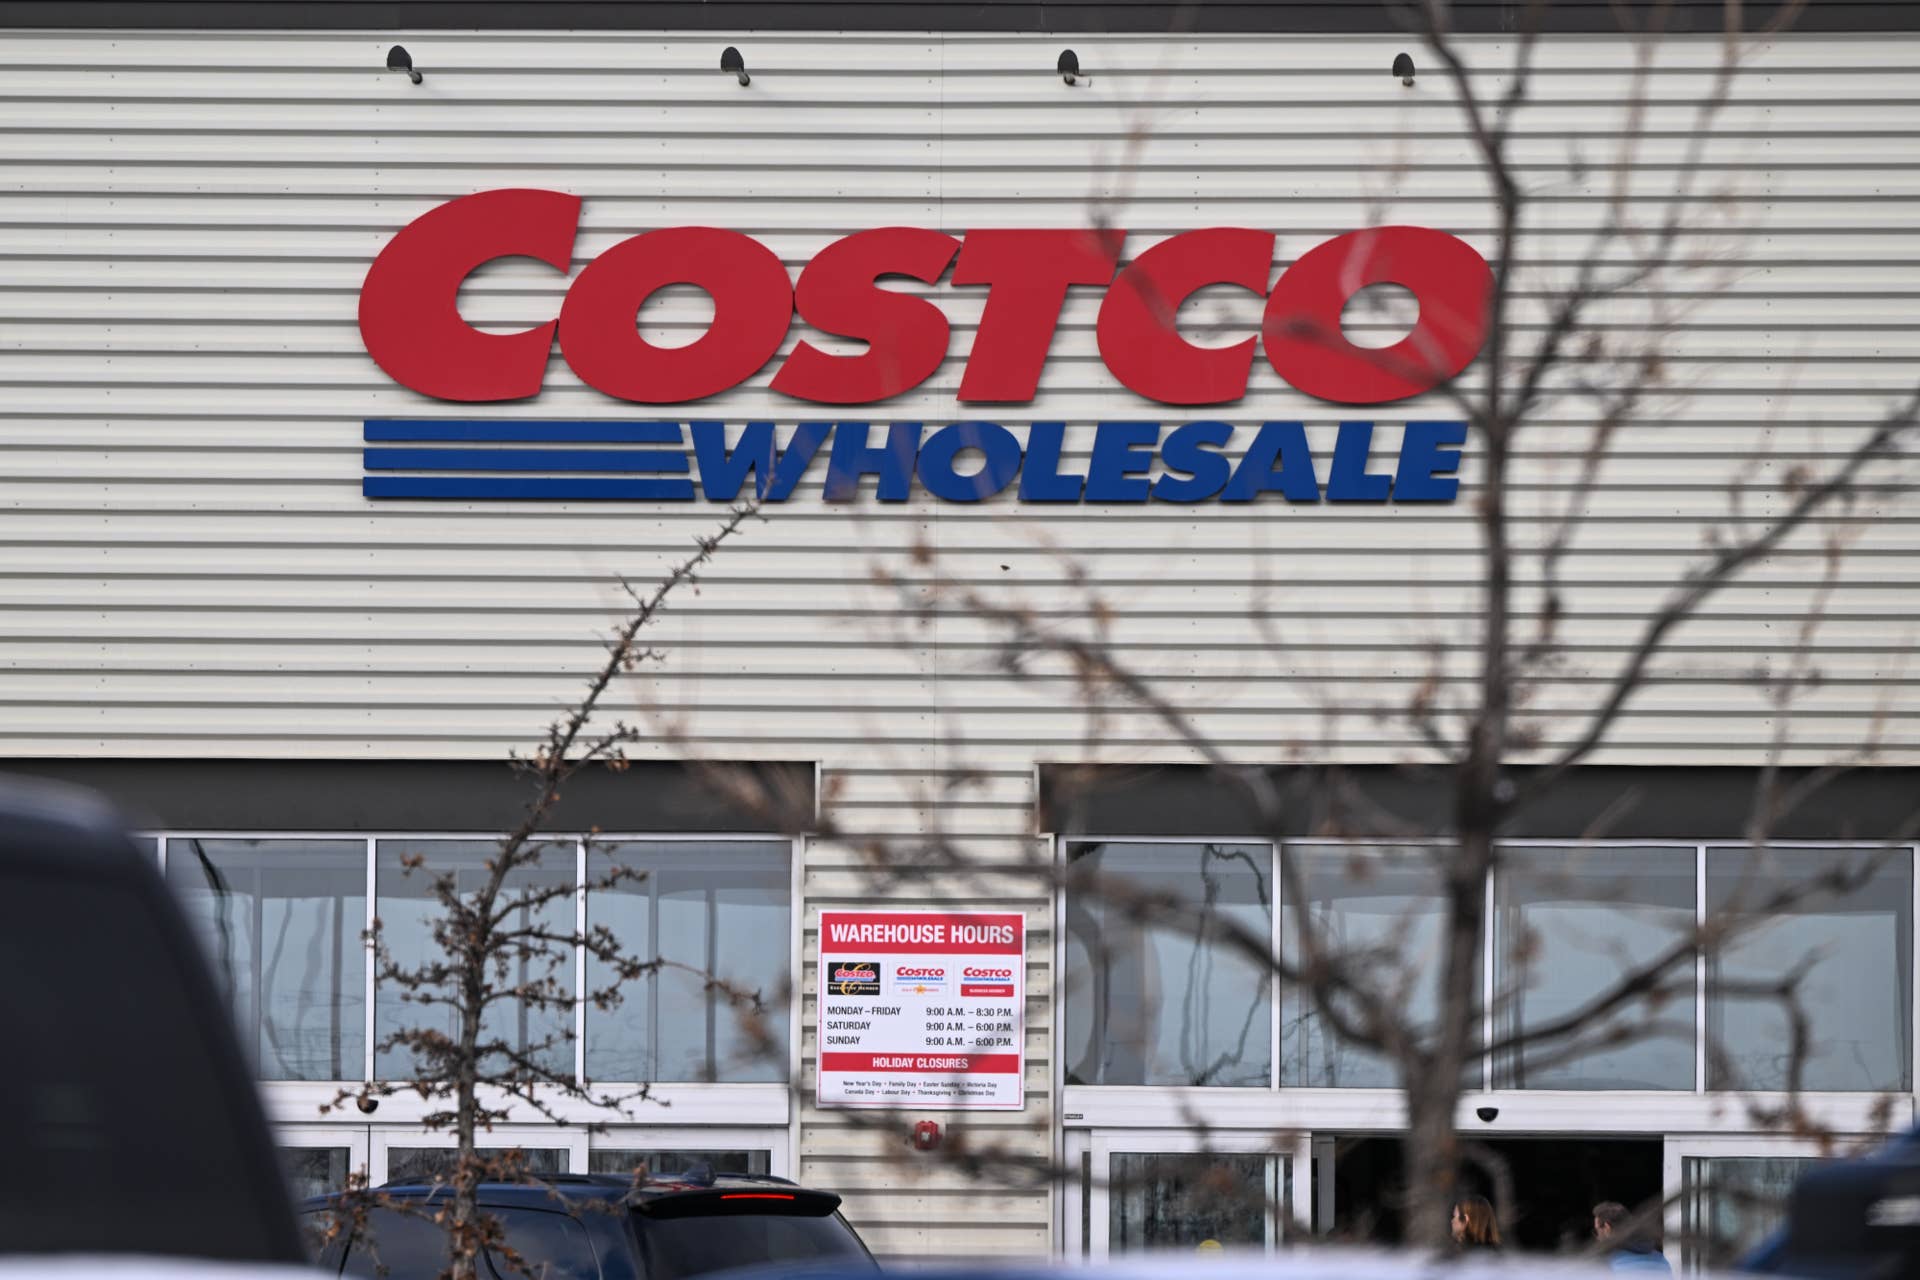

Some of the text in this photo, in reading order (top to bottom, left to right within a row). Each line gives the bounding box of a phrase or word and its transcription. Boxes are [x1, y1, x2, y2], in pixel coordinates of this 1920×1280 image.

[358, 188, 1494, 404] COSTCO
[690, 420, 1468, 502] WHOLESALE
[830, 924, 1014, 944] WAREHOUSE HOURS
[896, 966, 945, 977] COSTCO
[963, 967, 1012, 977] COSTCO
[827, 1006, 863, 1015] MONDAY
[871, 1007, 901, 1015] FRIDAY
[926, 1008, 944, 1017] 9:00
[947, 1008, 966, 1017] A.M.
[976, 1008, 994, 1017] 8:30
[997, 1008, 1014, 1017] P.M.
[827, 1021, 871, 1030] SATURDAY
[926, 1023, 944, 1031] 9:00
[947, 1023, 966, 1031] A.M.
[976, 1023, 994, 1032] 6:00
[997, 1023, 1014, 1032] P.M.
[827, 1036, 860, 1045] SUNDAY
[925, 1037, 944, 1046] 9:00
[947, 1037, 966, 1046] A.M.
[975, 1038, 994, 1047] 6:00
[996, 1038, 1014, 1047] P.M.
[872, 1057, 968, 1069] HOLIDAY CLOSURES
